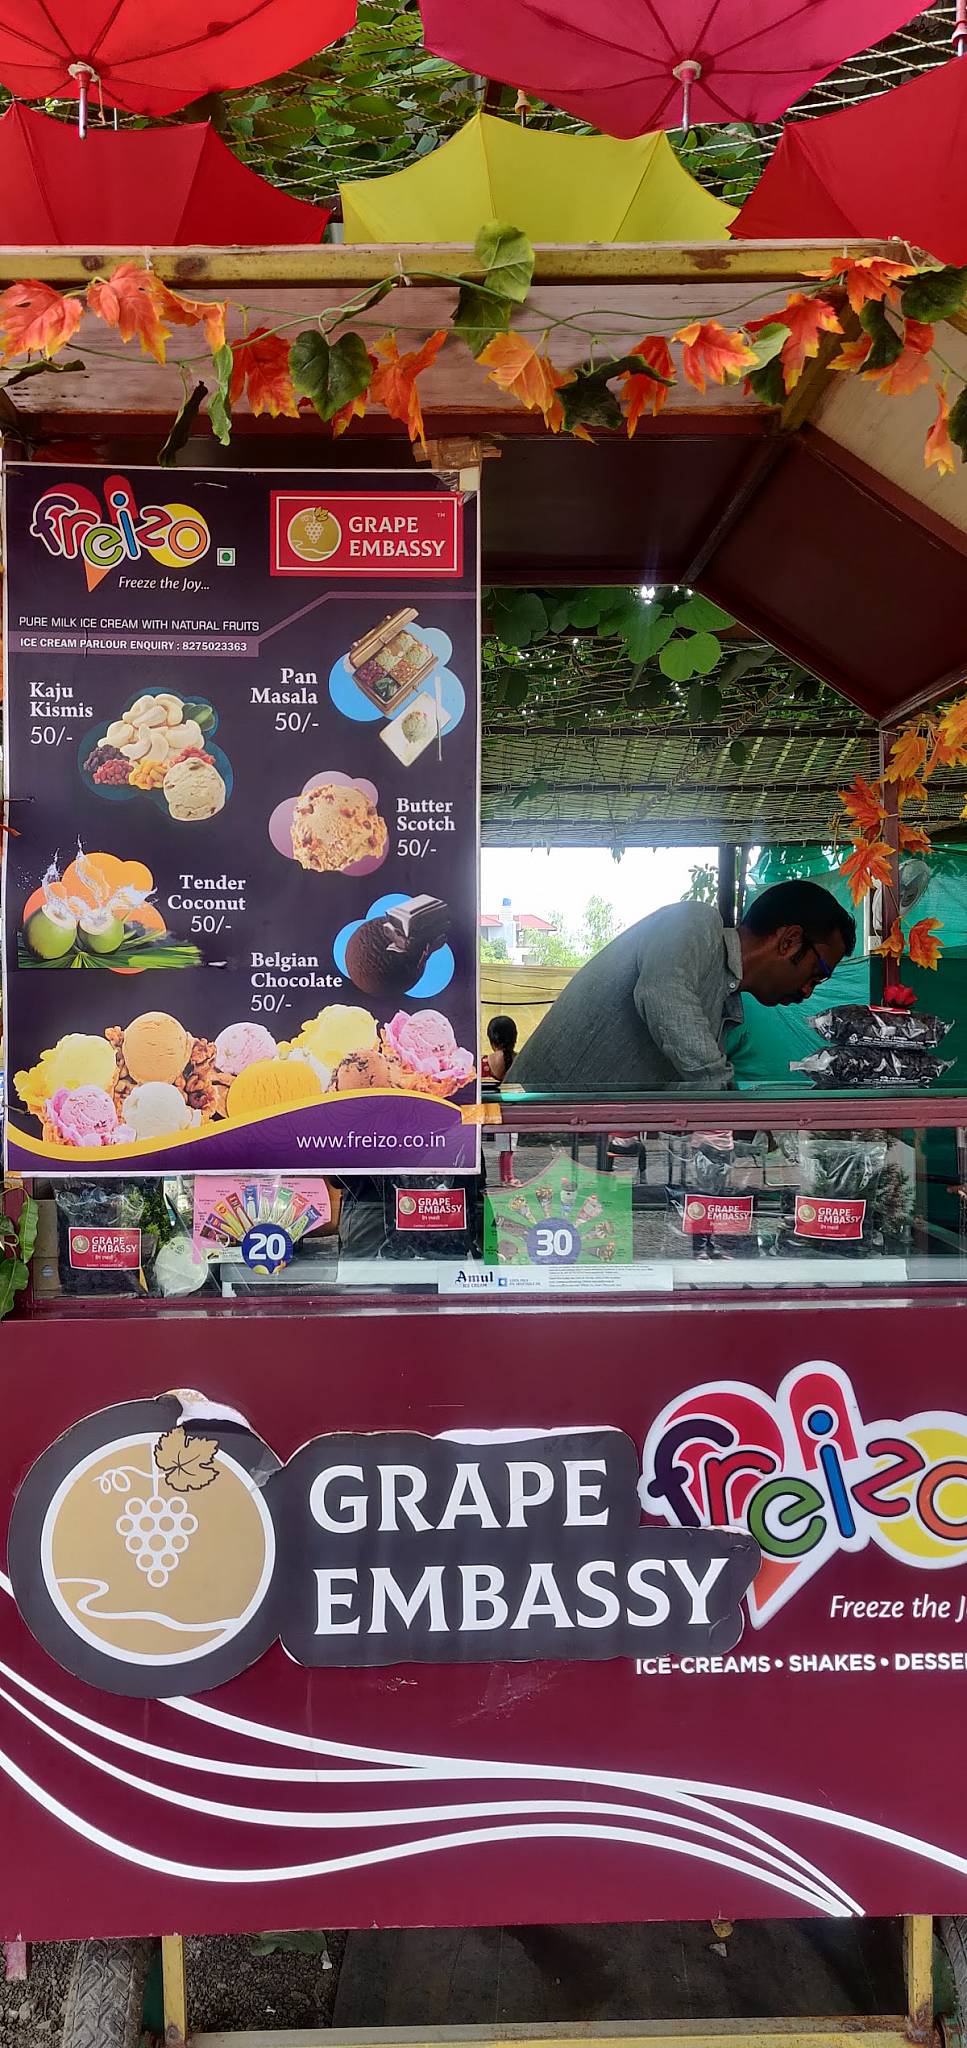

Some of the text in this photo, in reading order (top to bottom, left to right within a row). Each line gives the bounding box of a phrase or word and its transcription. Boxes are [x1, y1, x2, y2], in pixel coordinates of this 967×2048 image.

[30, 491, 211, 568] freizo
[348, 516, 419, 534] GRAPE
[349, 540, 446, 557] EMBASSY
[119, 576, 210, 593] Freeze the Joy...
[19, 616, 260, 631] PURE MILK ICE CREAM WITH NATURAL FRUITS
[20, 638, 37, 647] ICE
[40, 638, 77, 648] CREAM
[80, 639, 127, 649] PARLOUR
[130, 640, 175, 651] ENQUIRY
[182, 641, 247, 651] 8275023363
[280, 668, 318, 685] Pan
[29, 681, 74, 703] Kaju
[250, 687, 318, 705] Masala
[29, 701, 93, 718] Kismis
[274, 711, 319, 733] 50/-
[30, 726, 73, 747] 50/-
[396, 797, 453, 813] Butter
[396, 815, 456, 831] Scotch
[397, 838, 437, 859] 50/-
[179, 874, 246, 891] Tender
[167, 894, 246, 911] Coconut
[190, 915, 232, 934] 50/-
[251, 952, 319, 972] Belgian
[250, 972, 343, 989] Chocolate
[250, 994, 292, 1013] 50/-
[296, 1130, 446, 1149] www.freizo.co.in
[418, 1197, 451, 1206] GRAPE
[418, 1204, 462, 1214] EMBASSY
[707, 1204, 740, 1213] GRAPE
[707, 1211, 750, 1220] EMBASSY
[817, 1214, 862, 1224] EMBASSY
[818, 1207, 852, 1216] GRAPE
[91, 1236, 125, 1245] GRAPE
[91, 1244, 137, 1253] EMBASSY
[248, 1233, 286, 1260] 20
[536, 1229, 573, 1256] 30
[455, 1270, 494, 1285] Amul
[308, 1458, 609, 1534] GRAPE
[312, 1557, 730, 1636] EMBASSY
[830, 1595, 904, 1619] Freeze
[912, 1593, 951, 1619] the
[635, 1653, 967, 1675] ICE-CREAMS SHAKES DESSE
